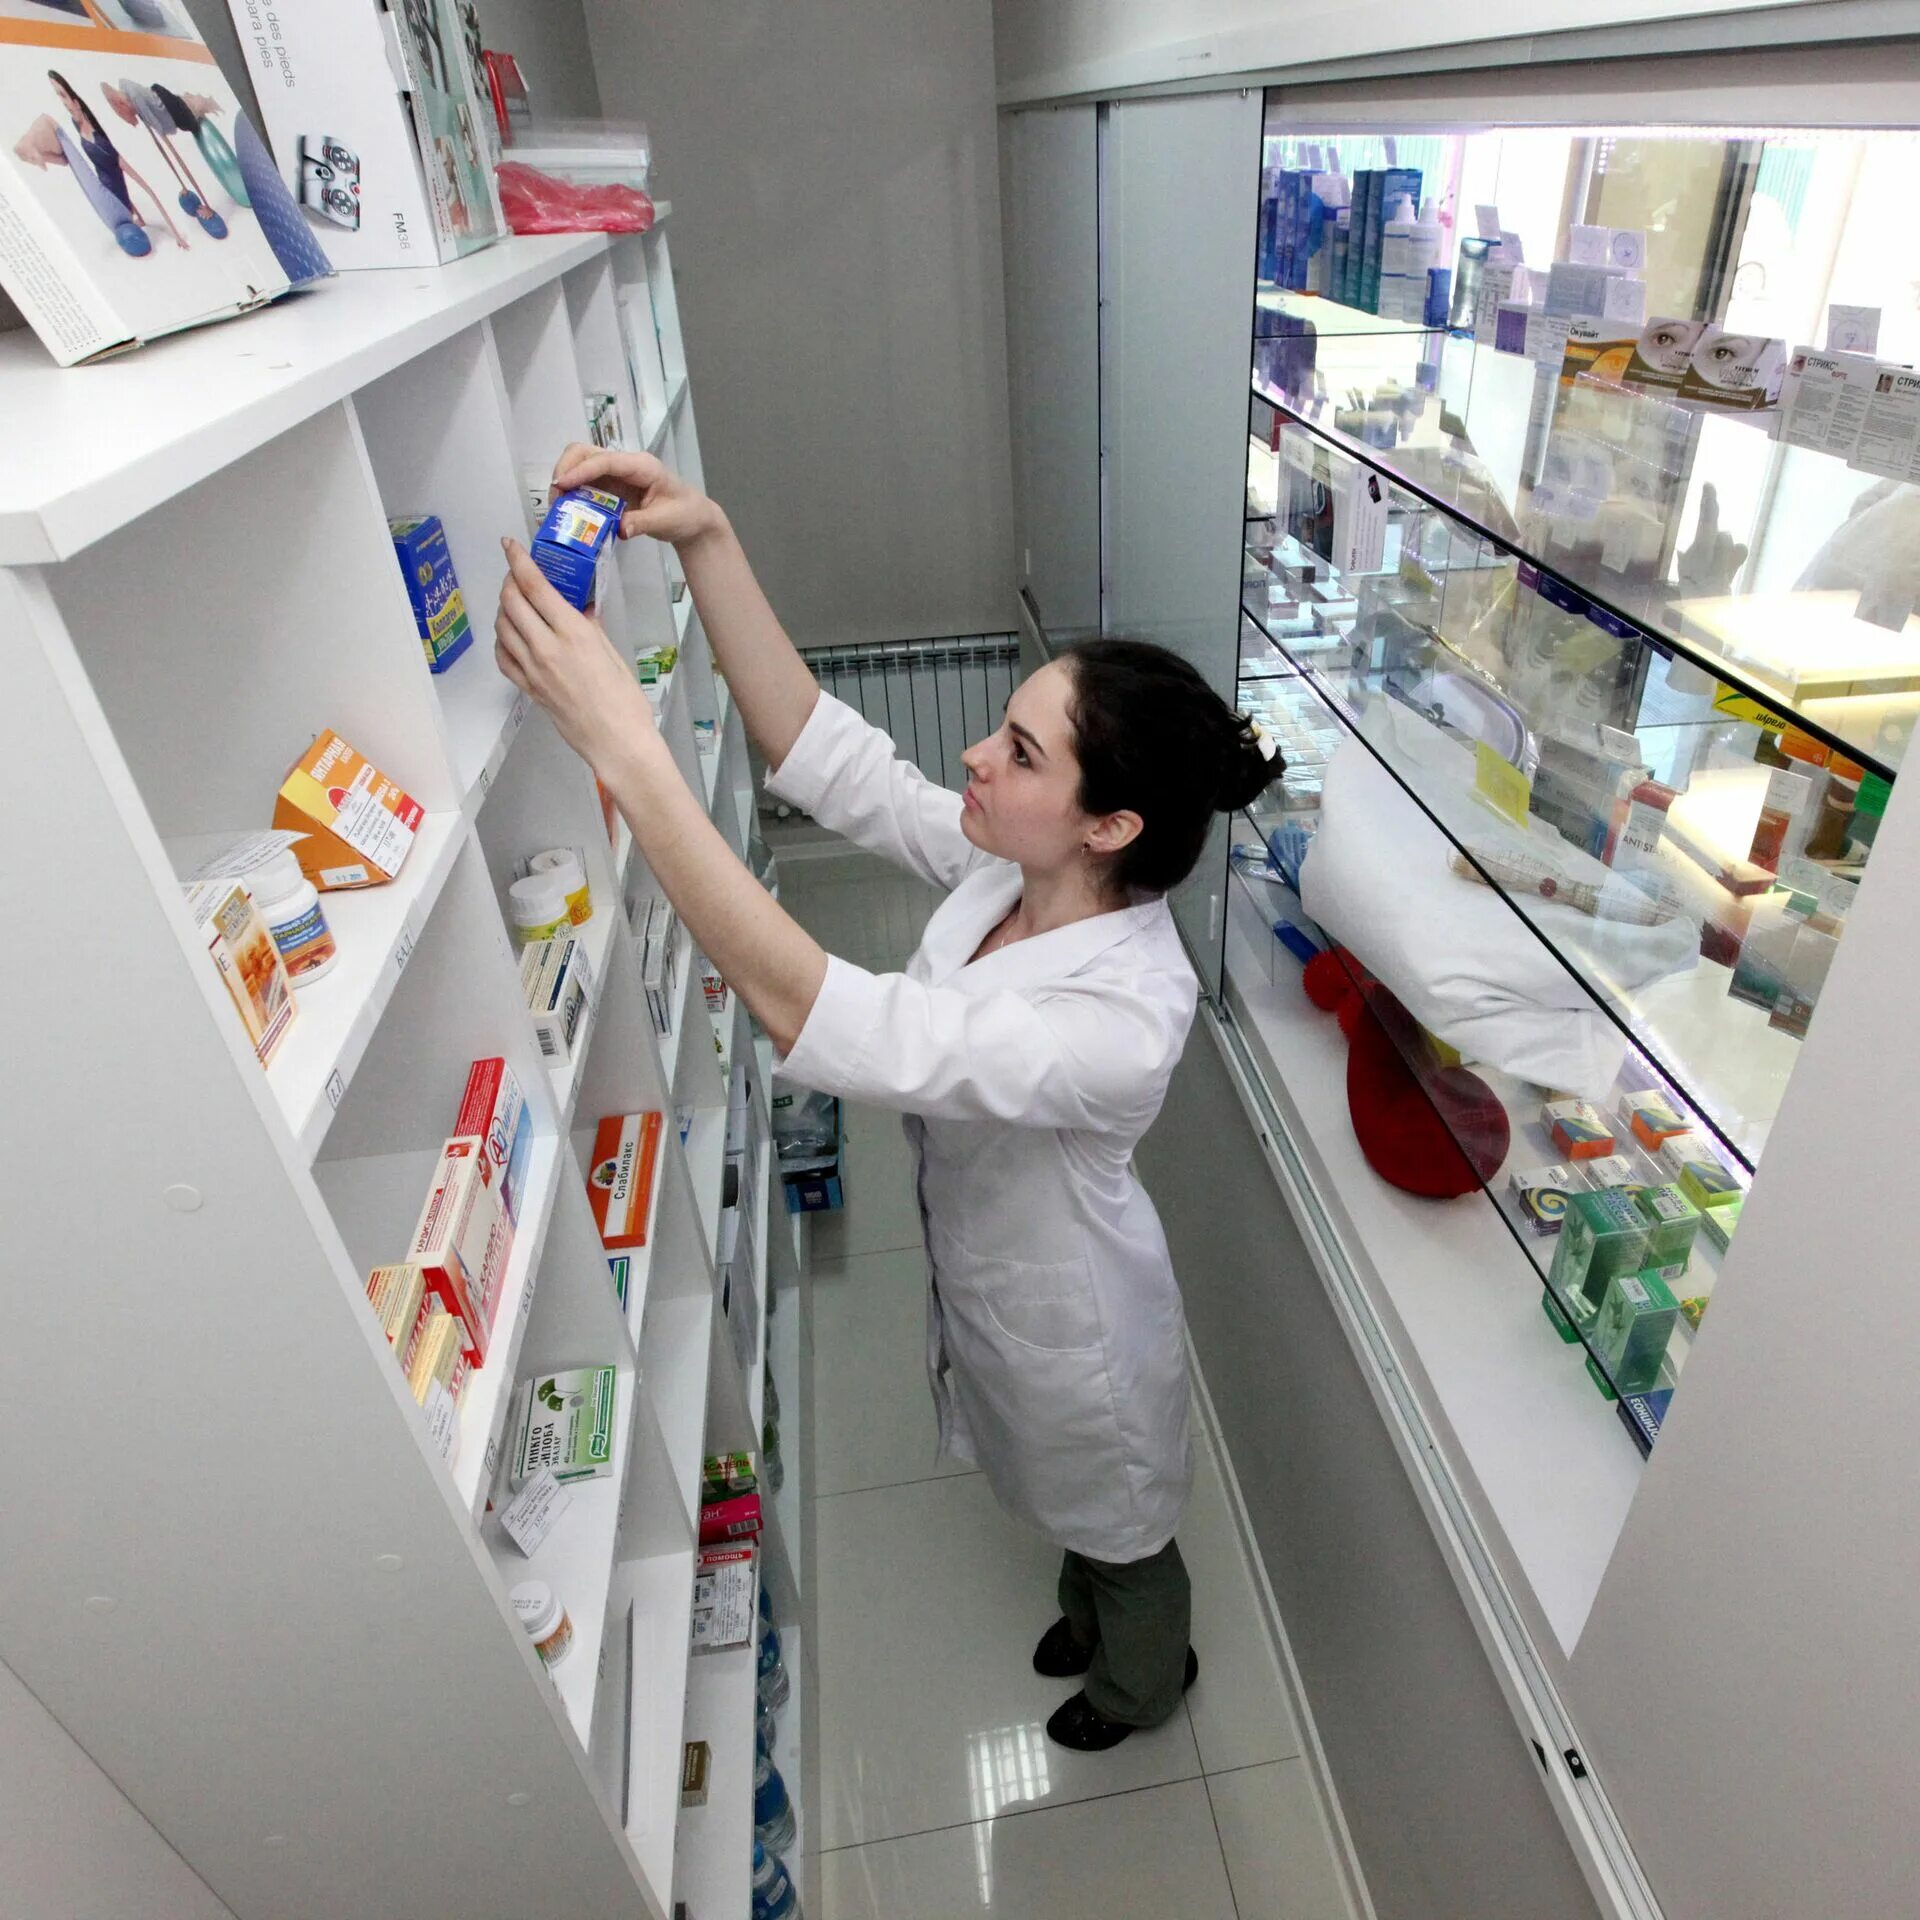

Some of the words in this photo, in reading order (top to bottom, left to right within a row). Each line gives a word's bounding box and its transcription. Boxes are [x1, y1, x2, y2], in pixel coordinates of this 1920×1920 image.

[266, 12, 282, 40] des
[254, 36, 274, 68] pies
[273, 46, 295, 88] pieds
[393, 213, 410, 250] FM38
[1807, 357, 1835, 370] СТРИКС
[1754, 711, 1787, 730] oradyn
[614, 1142, 634, 1200] Слабилакс
[1630, 1397, 1660, 1439] ОГИПНОЗ
[528, 1426, 543, 1471] ГИНКГО
[551, 1436, 561, 1465] ЭВАЛАР
[706, 1553, 744, 1563] ПОМОЩЬ
